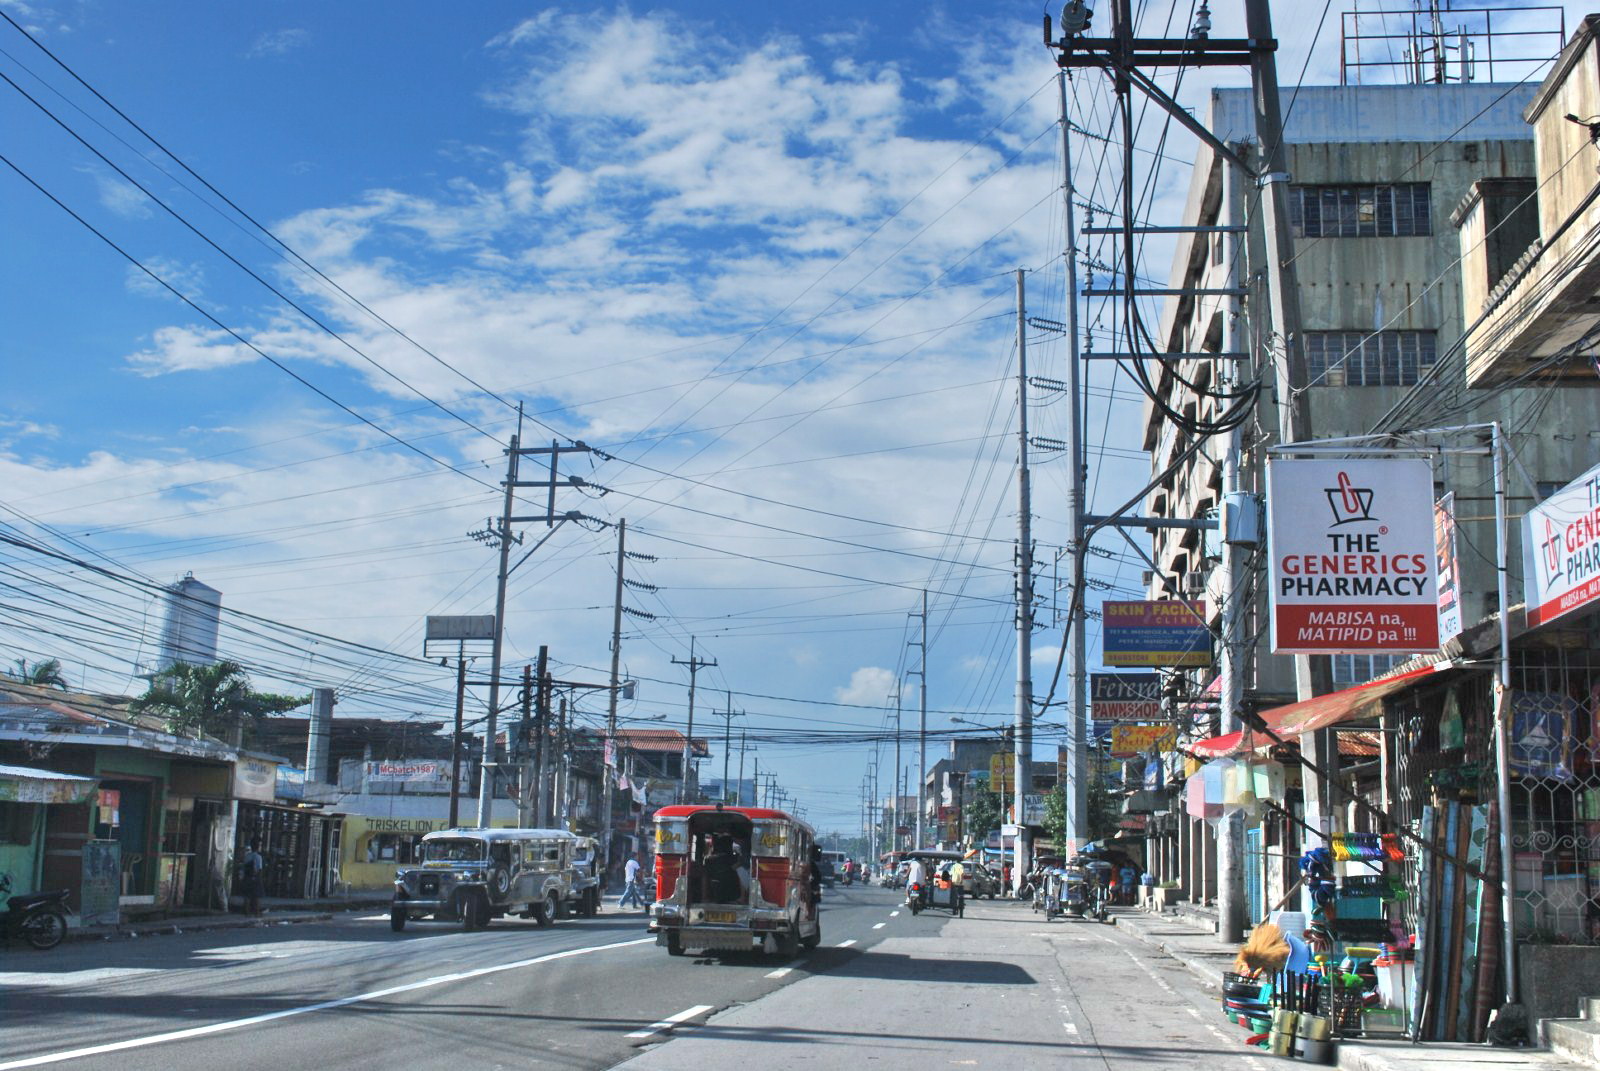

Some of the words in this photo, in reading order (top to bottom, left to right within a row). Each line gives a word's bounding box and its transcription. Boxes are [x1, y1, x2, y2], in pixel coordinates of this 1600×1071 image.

[1327, 534, 1380, 552] THE
[1281, 554, 1427, 574] GENERICS
[1281, 577, 1428, 596] PHARMACY
[1109, 605, 1145, 616] SKIN
[1152, 604, 1204, 616] FACIAL
[1308, 612, 1375, 625] MABISA
[1380, 614, 1405, 627] na,
[1297, 627, 1373, 641] MATIPID
[1377, 630, 1398, 643] pa
[1093, 703, 1160, 718] PAWNSHOP
[369, 819, 433, 832] TRISKELION
